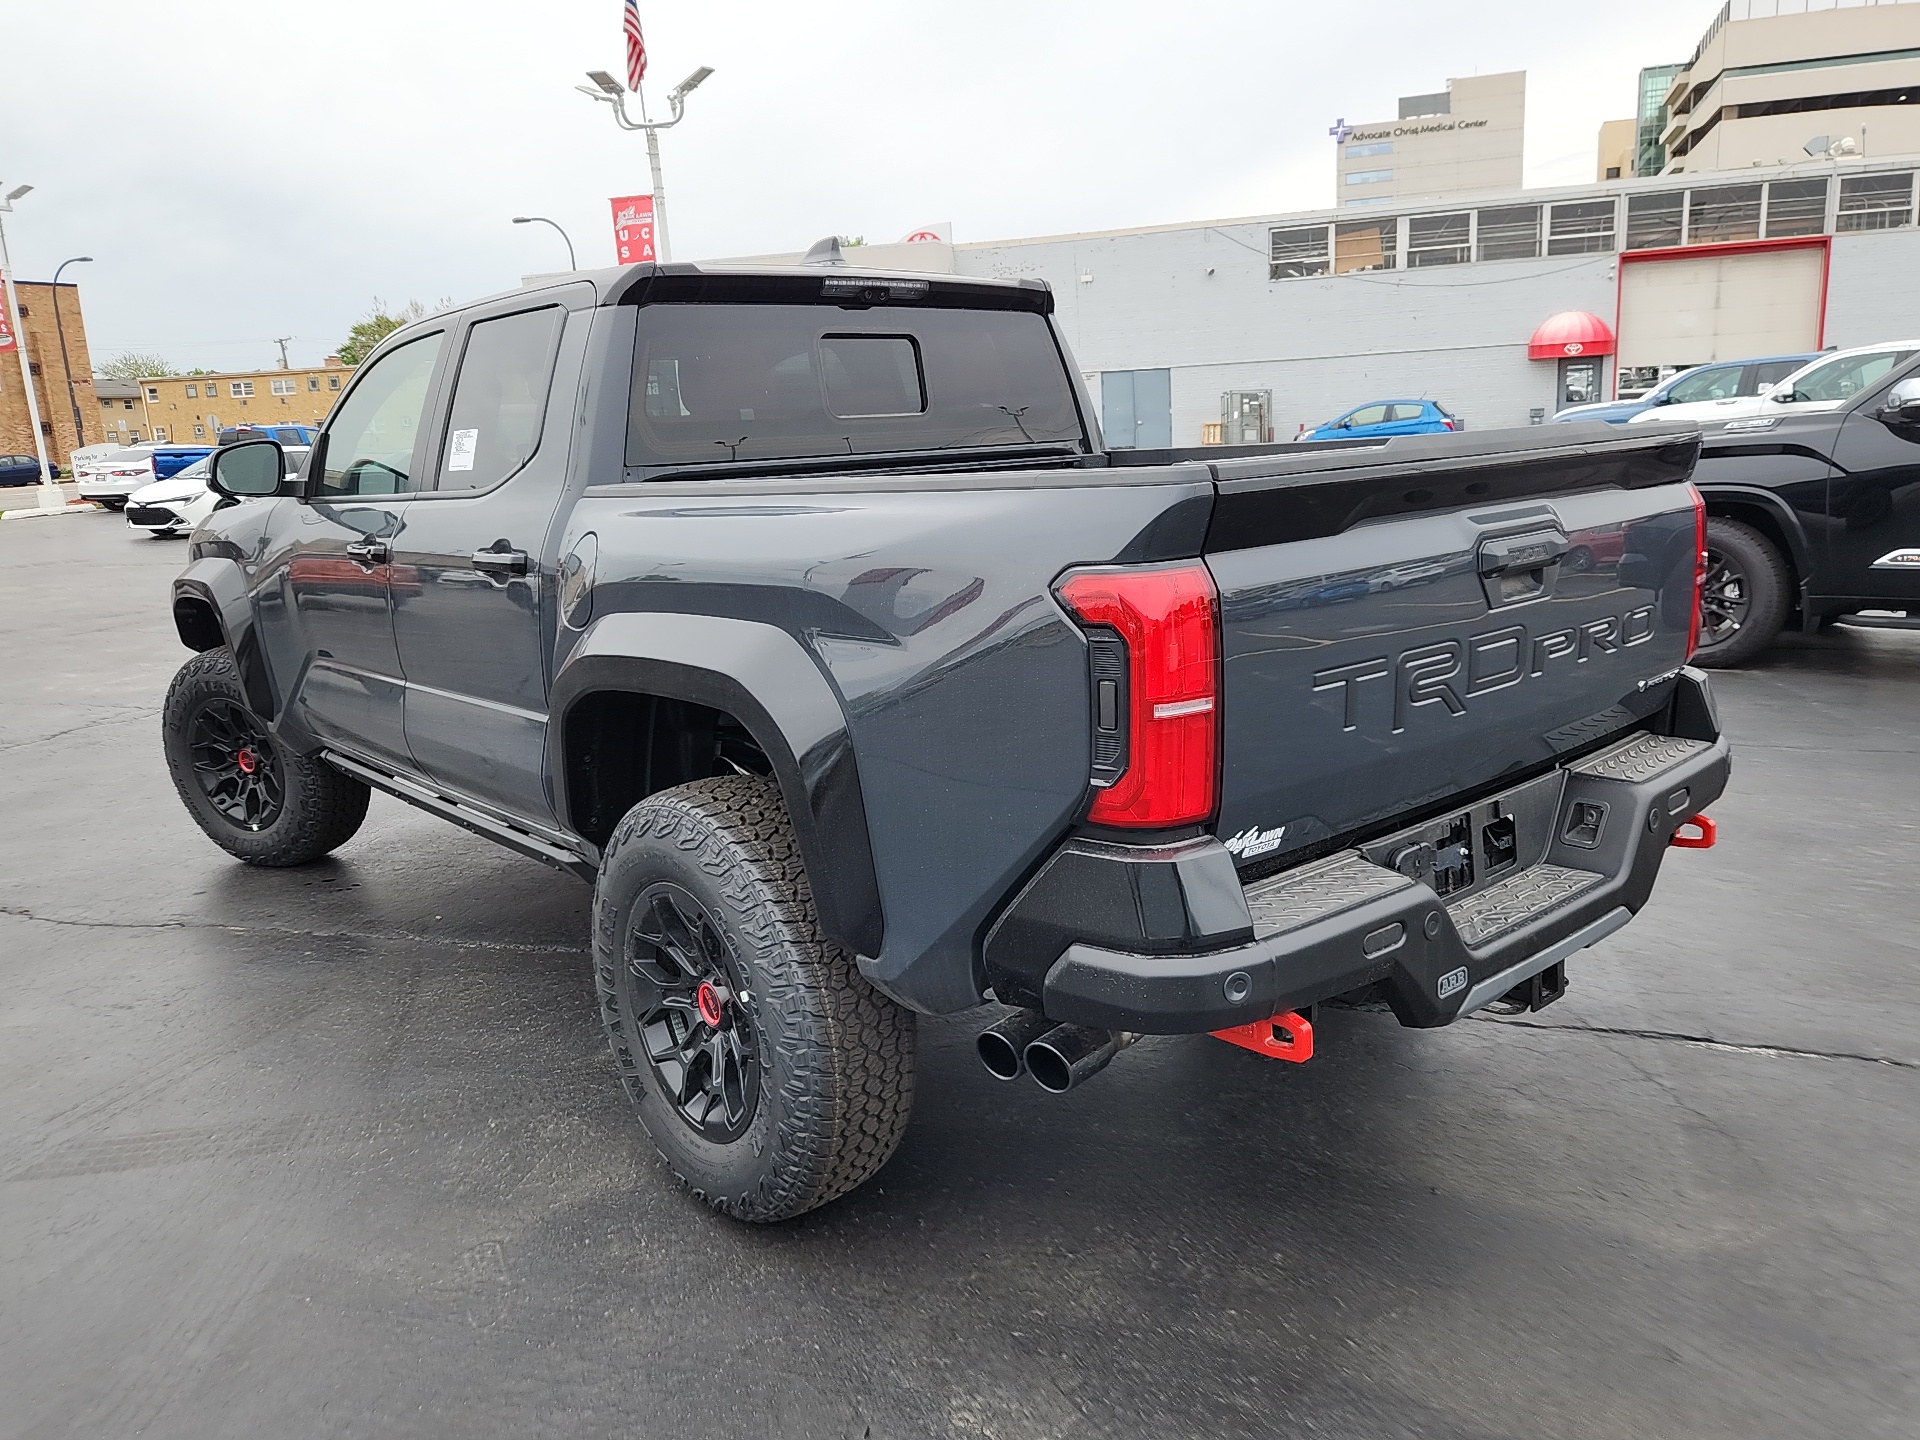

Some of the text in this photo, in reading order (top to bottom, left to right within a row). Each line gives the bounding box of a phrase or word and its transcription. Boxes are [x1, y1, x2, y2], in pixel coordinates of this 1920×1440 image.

[1352, 119, 1488, 141] Advocate Christ Medical Center
[1313, 604, 1656, 734] TRD PRO
[1248, 841, 1275, 854] TOYOTA
[1441, 971, 1465, 995] ARB
